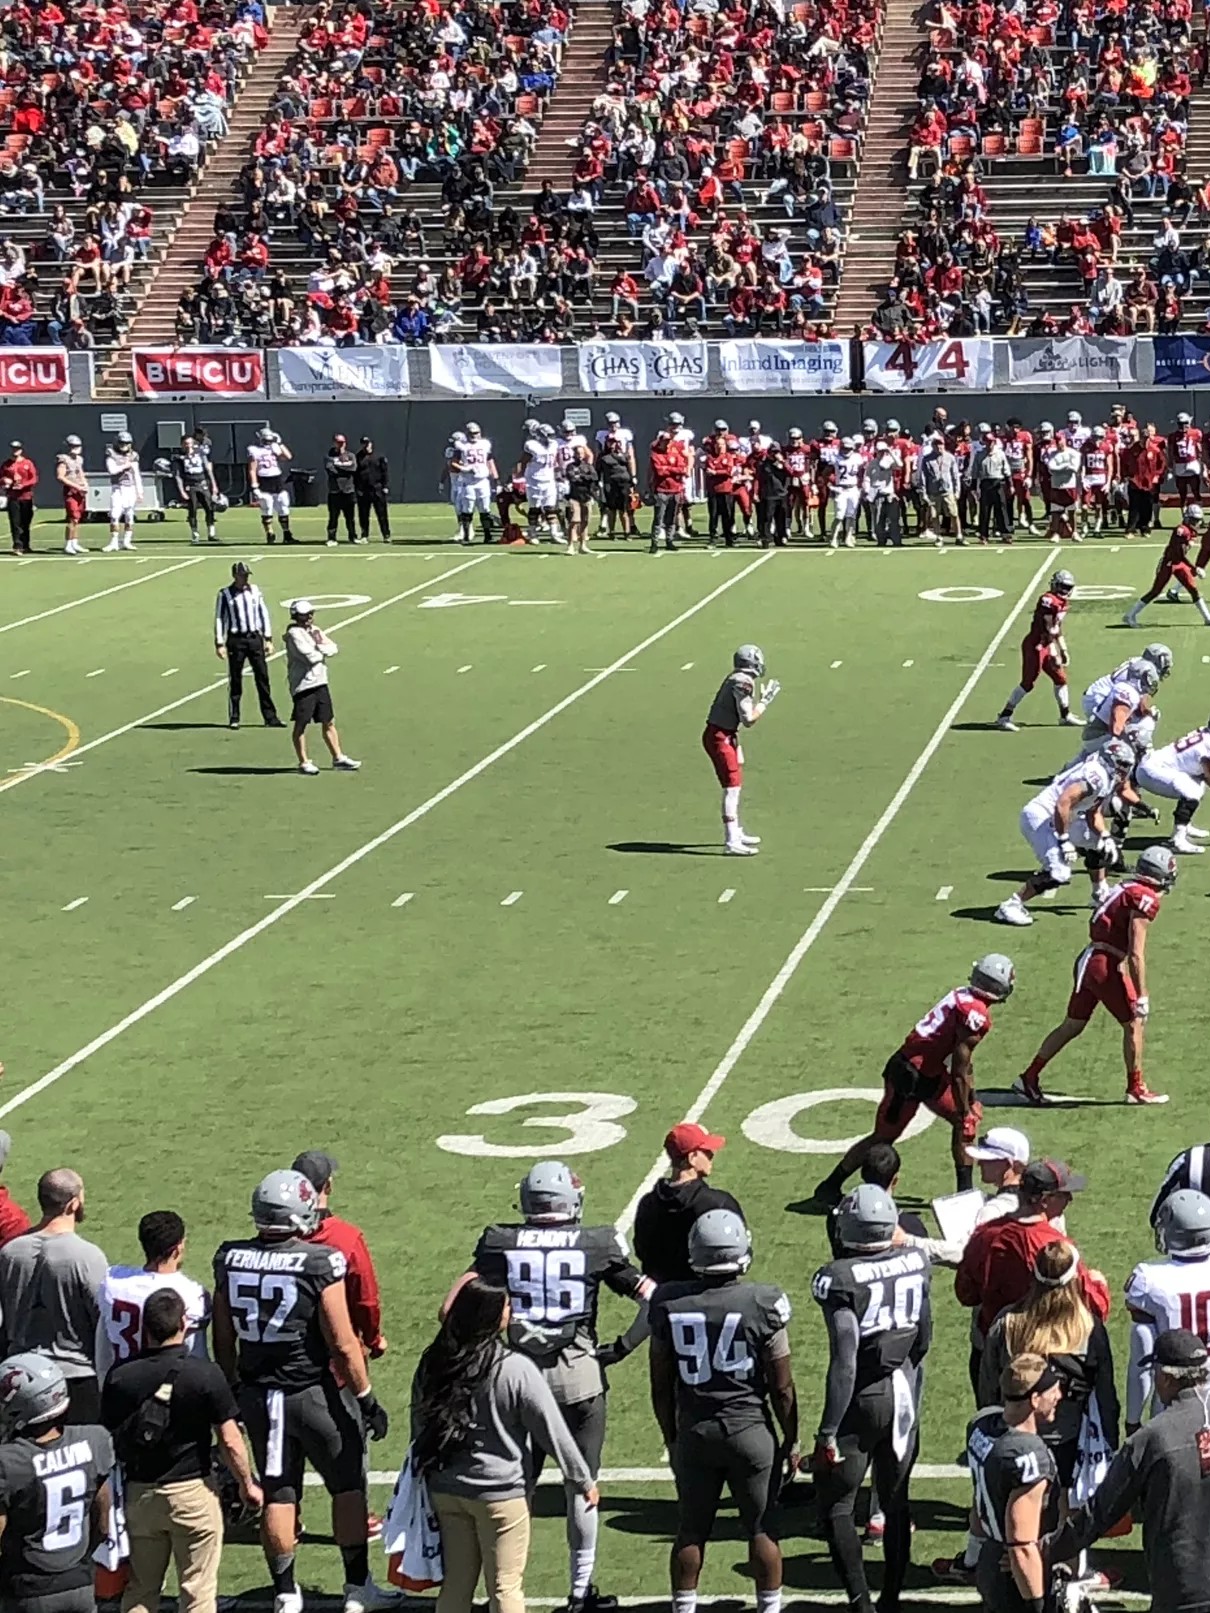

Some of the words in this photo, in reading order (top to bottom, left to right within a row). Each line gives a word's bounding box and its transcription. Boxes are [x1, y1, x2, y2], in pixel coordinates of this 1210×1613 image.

[146, 361, 253, 384] BECU
[590, 354, 640, 379] CHAS
[653, 354, 703, 379] CHAS
[774, 355, 843, 374] Imaging
[517, 1229, 581, 1249] HENDRY
[224, 1248, 308, 1273] FERNANDEZ
[505, 1250, 586, 1323] 96
[227, 1271, 300, 1343] 52
[667, 1311, 756, 1387] 94
[32, 1440, 94, 1477] CALVIN
[1014, 1451, 1041, 1485] 21
[42, 1469, 88, 1552] 6
